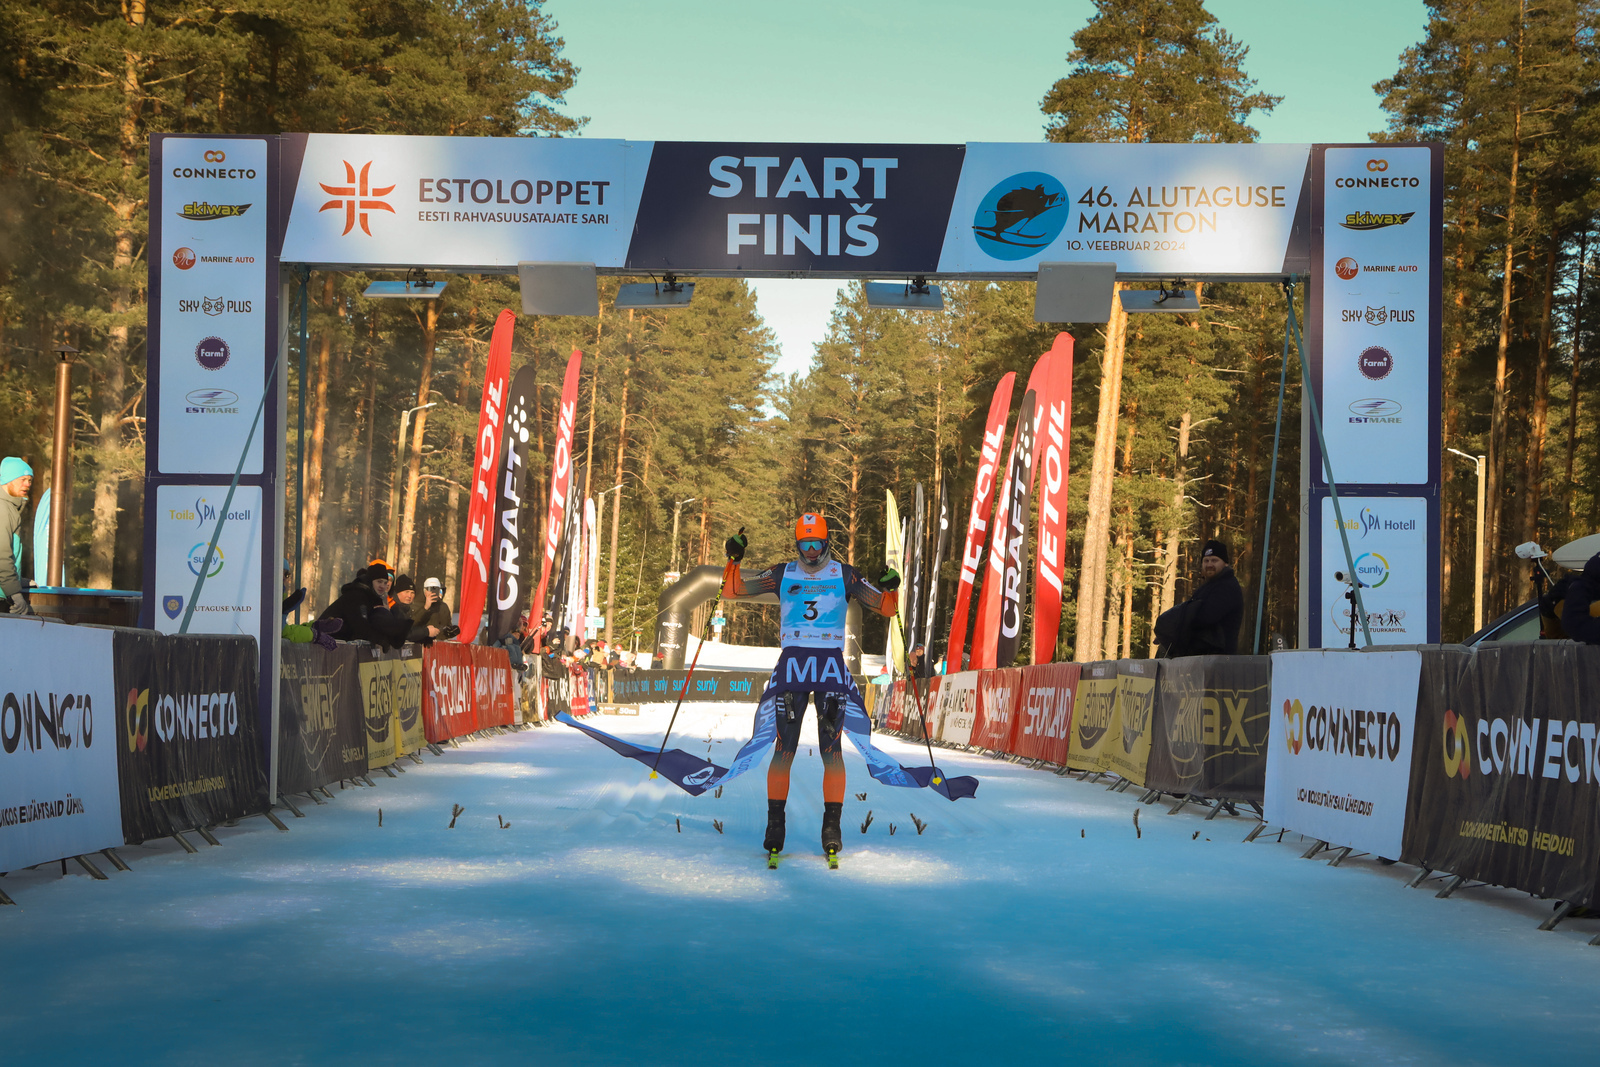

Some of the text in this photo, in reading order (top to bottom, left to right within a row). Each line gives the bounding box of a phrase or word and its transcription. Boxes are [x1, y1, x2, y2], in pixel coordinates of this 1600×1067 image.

[173, 167, 256, 179] CONNECTO
[708, 155, 899, 199] START
[1335, 177, 1420, 188] CONNECTO
[419, 178, 610, 205] ESTOLOPPET
[1077, 185, 1286, 208] 46. ALUTAGUSE
[184, 202, 240, 215] skiwax
[418, 211, 609, 224] EESTI RAHVASUUSATAJATE SARI
[1078, 211, 1217, 233] MARATON
[1346, 211, 1403, 225] skiwax
[727, 202, 879, 257] FINIŠ
[1066, 240, 1186, 251] 10. VEEBRUAR 2024
[200, 255, 255, 264] MARIINE AUTO
[179, 300, 252, 313] SKY PLUS
[1341, 309, 1415, 322] SKY PLUS
[547, 400, 575, 564] JETOIL
[1039, 400, 1066, 603] JETOIL
[169, 509, 195, 520] Toila
[496, 437, 522, 611] CRAFT
[1384, 519, 1416, 530] Hotell
[193, 555, 219, 566] suy
[1001, 466, 1026, 639] CRAFT
[1358, 565, 1384, 576] sunly
[802, 600, 819, 621] 3
[654, 676, 669, 695] sunly
[696, 677, 719, 695] sunly
[729, 678, 753, 695] sunly
[154, 691, 238, 743] CONNECTO
[1305, 704, 1401, 762] CONNECTO
